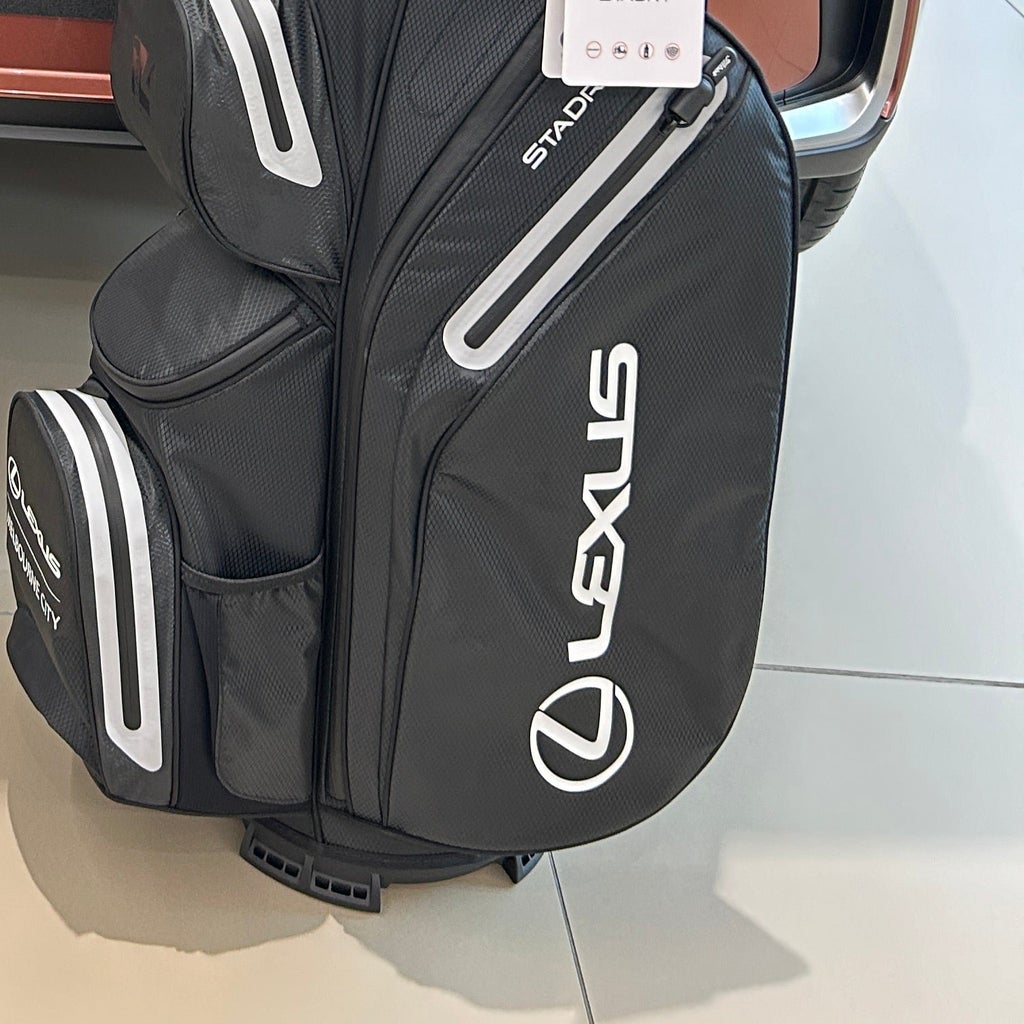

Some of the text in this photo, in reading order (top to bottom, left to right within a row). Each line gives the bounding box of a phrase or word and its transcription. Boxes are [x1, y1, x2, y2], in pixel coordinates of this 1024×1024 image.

[20, 489, 61, 579] LEXUS
[567, 342, 638, 663] LEXUS
[40, 592, 61, 630] CITY
